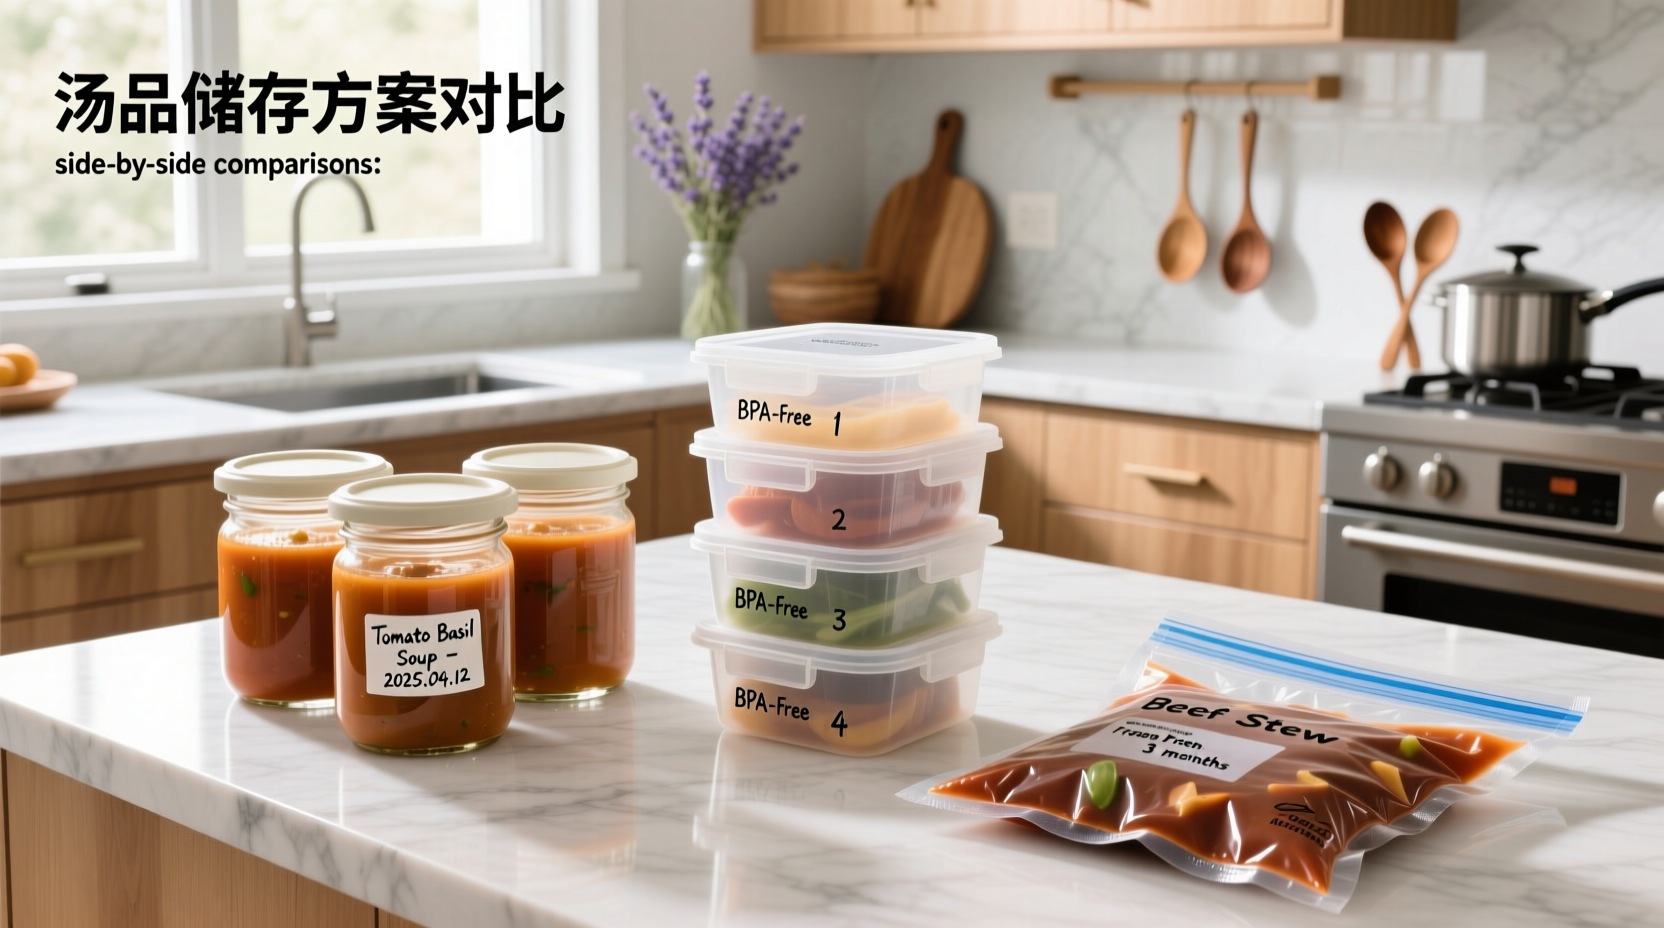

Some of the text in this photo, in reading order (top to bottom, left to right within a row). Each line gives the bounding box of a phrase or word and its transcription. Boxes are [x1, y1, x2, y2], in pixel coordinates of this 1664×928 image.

[738, 399, 841, 436] BPA-Free 1
[831, 509, 847, 530] 2
[735, 587, 847, 631] BPA-Free 3
[371, 618, 474, 645] Tomato Basil
[396, 649, 438, 671] Soup
[383, 667, 471, 688] 2025.04.12
[734, 687, 849, 737] BPA-Free 4
[1141, 697, 1340, 744] Beef Stew
[1141, 743, 1157, 754] 3
